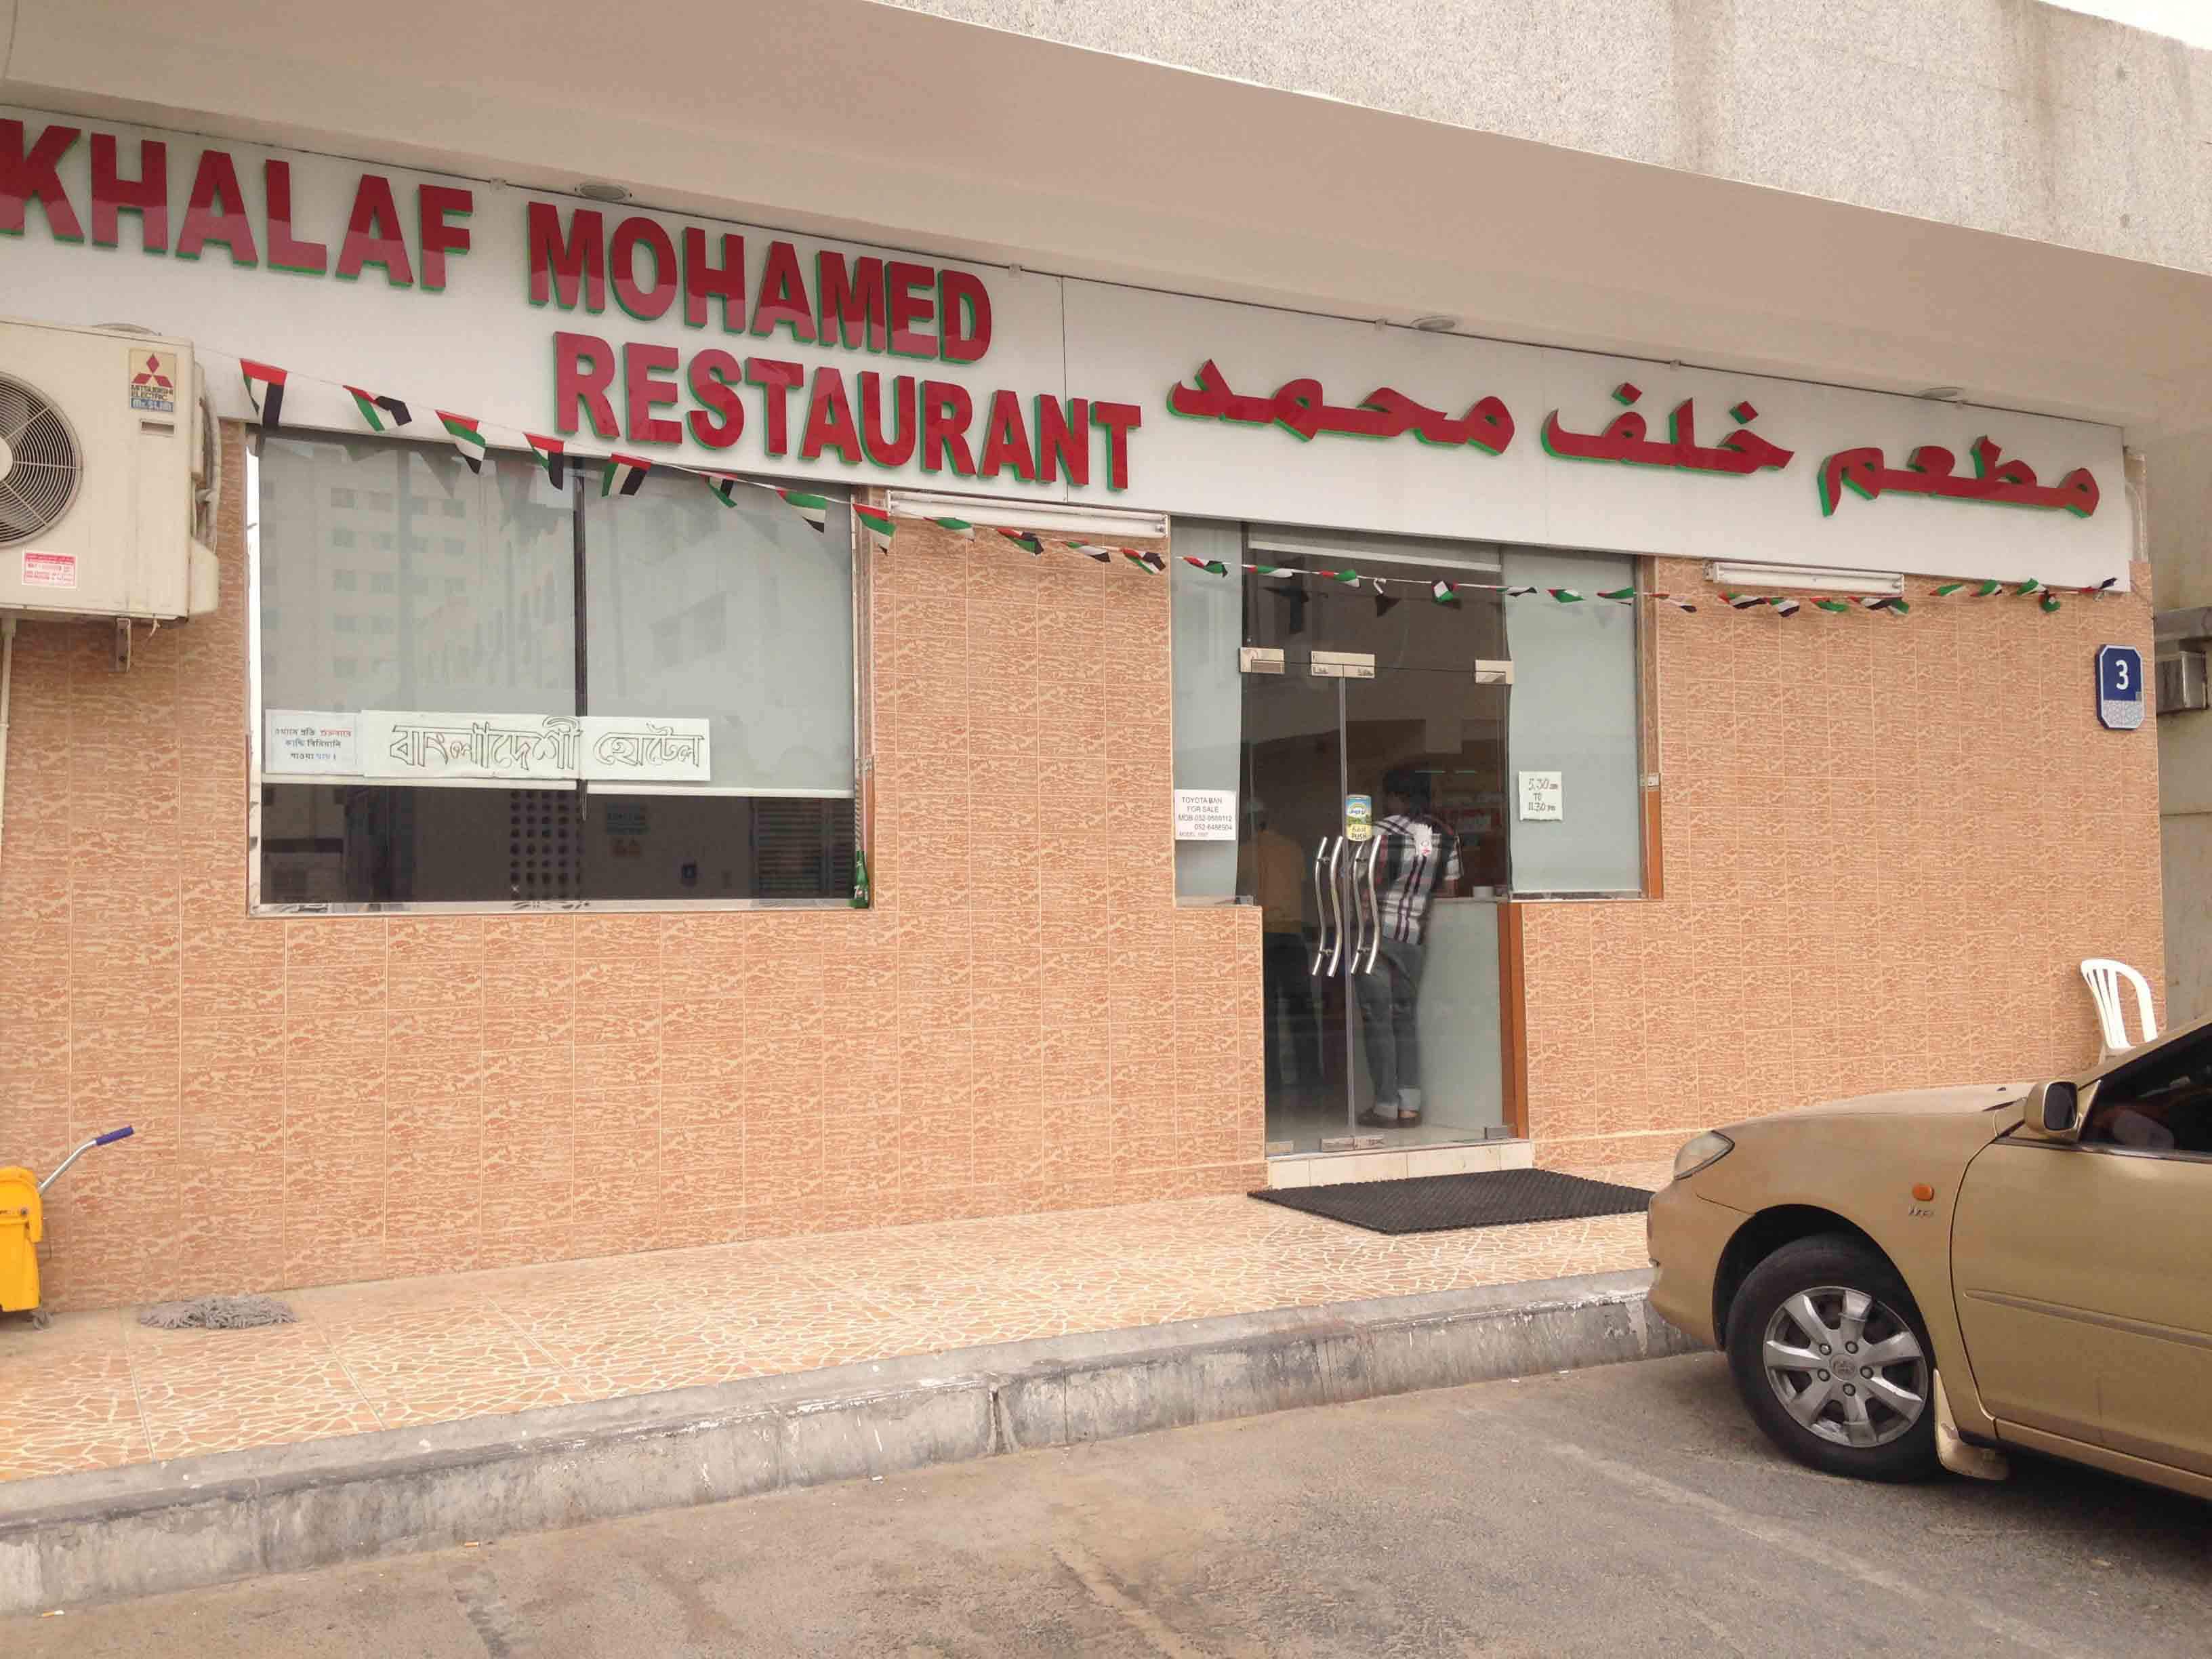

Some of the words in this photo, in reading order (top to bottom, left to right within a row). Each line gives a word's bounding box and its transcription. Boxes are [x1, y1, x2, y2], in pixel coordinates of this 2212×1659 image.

[0, 118, 474, 291] KHALAF
[527, 201, 993, 365] MOHAMED
[553, 331, 1142, 491] RESTAURANT
[1166, 358, 1516, 457] محمد
[1540, 382, 1795, 476] خلف
[1817, 434, 2100, 518] مطعم
[2115, 659, 2129, 690] 3
[1202, 805, 1219, 813] SALE
